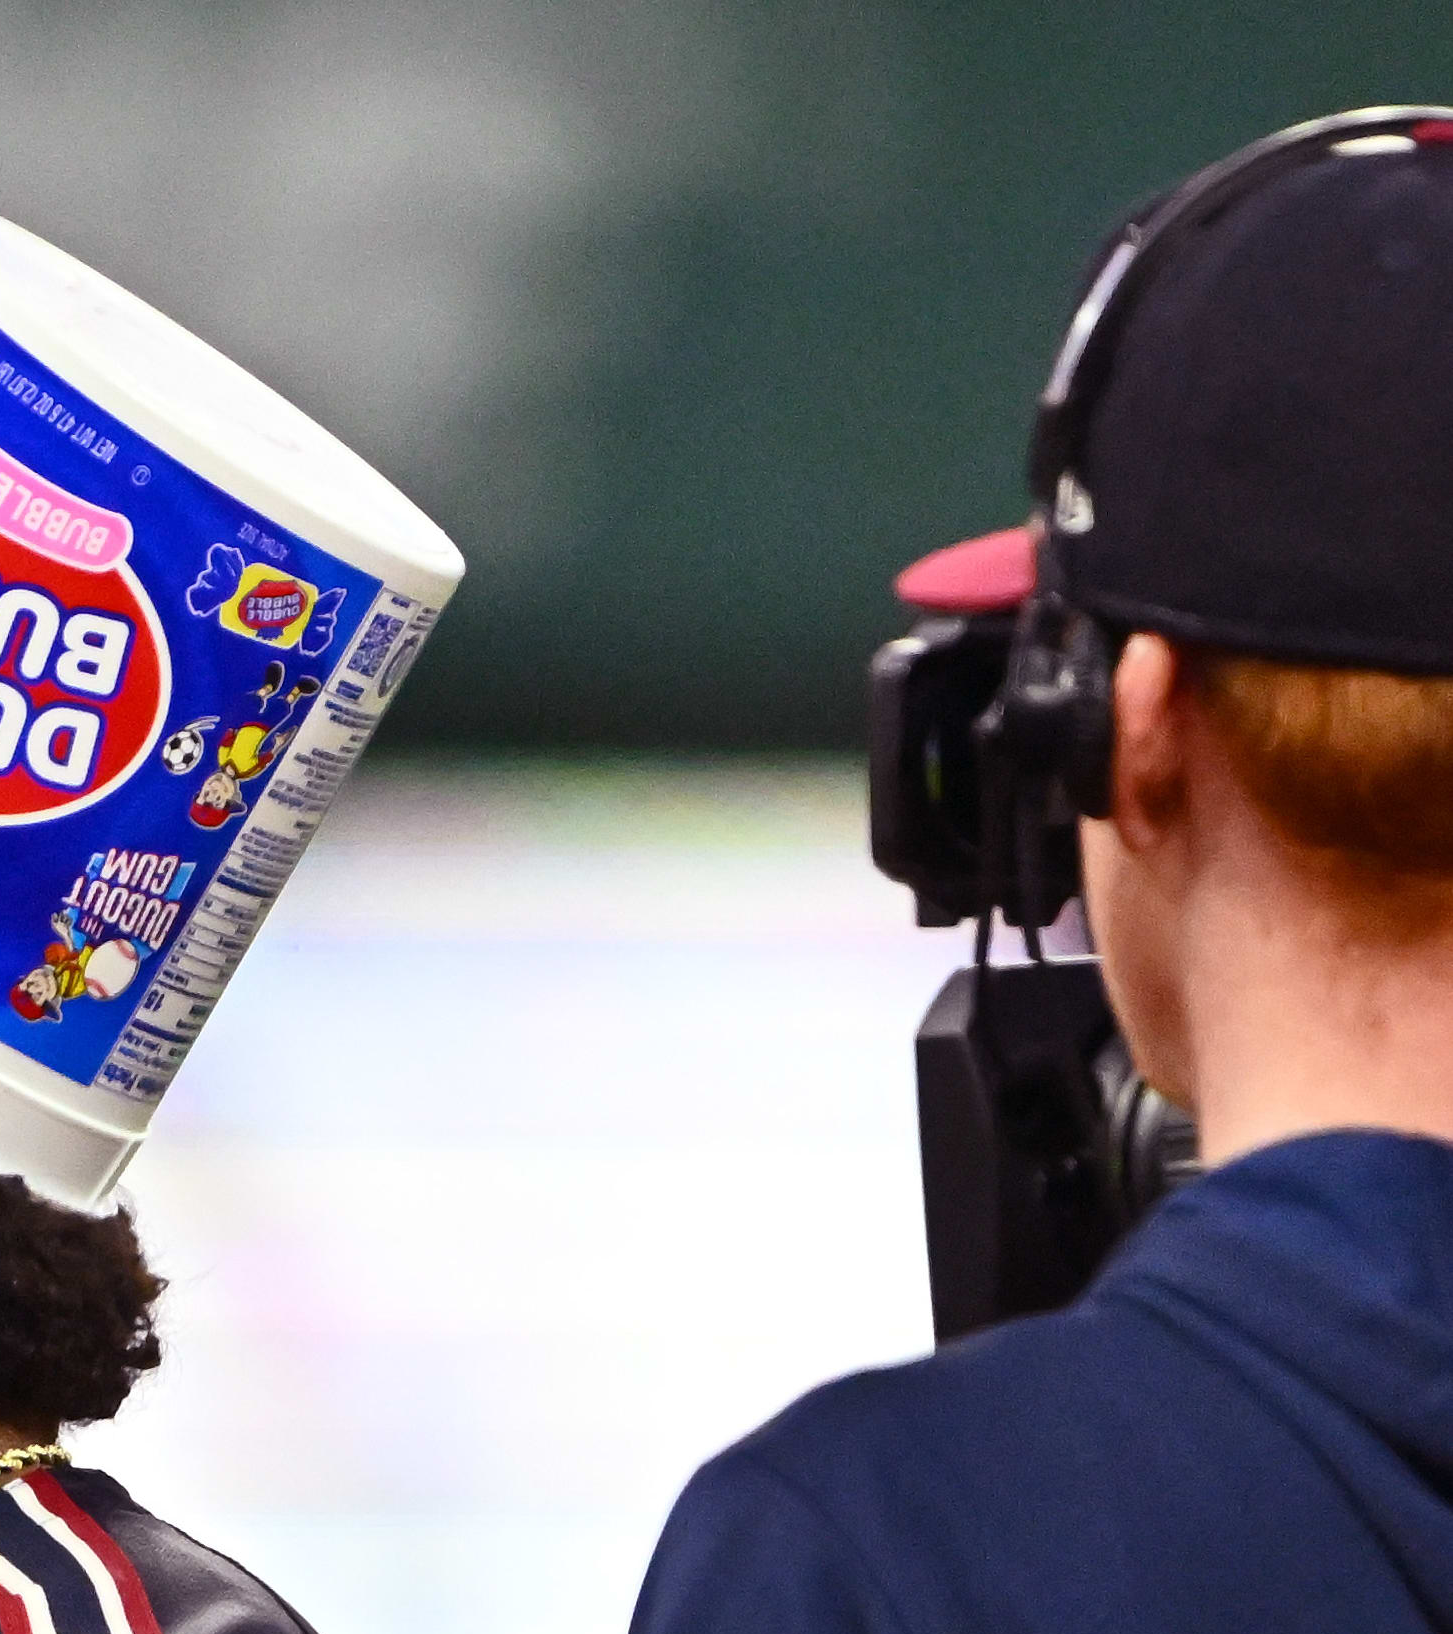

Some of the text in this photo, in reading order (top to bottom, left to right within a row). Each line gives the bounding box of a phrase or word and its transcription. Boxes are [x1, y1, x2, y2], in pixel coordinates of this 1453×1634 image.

[31, 391, 53, 415] OZ
[47, 402, 75, 432] 47.6
[69, 422, 97, 449] WT
[247, 603, 299, 619] DUBBLE
[99, 846, 178, 895] GUM
[60, 875, 179, 950] DUGOUT
